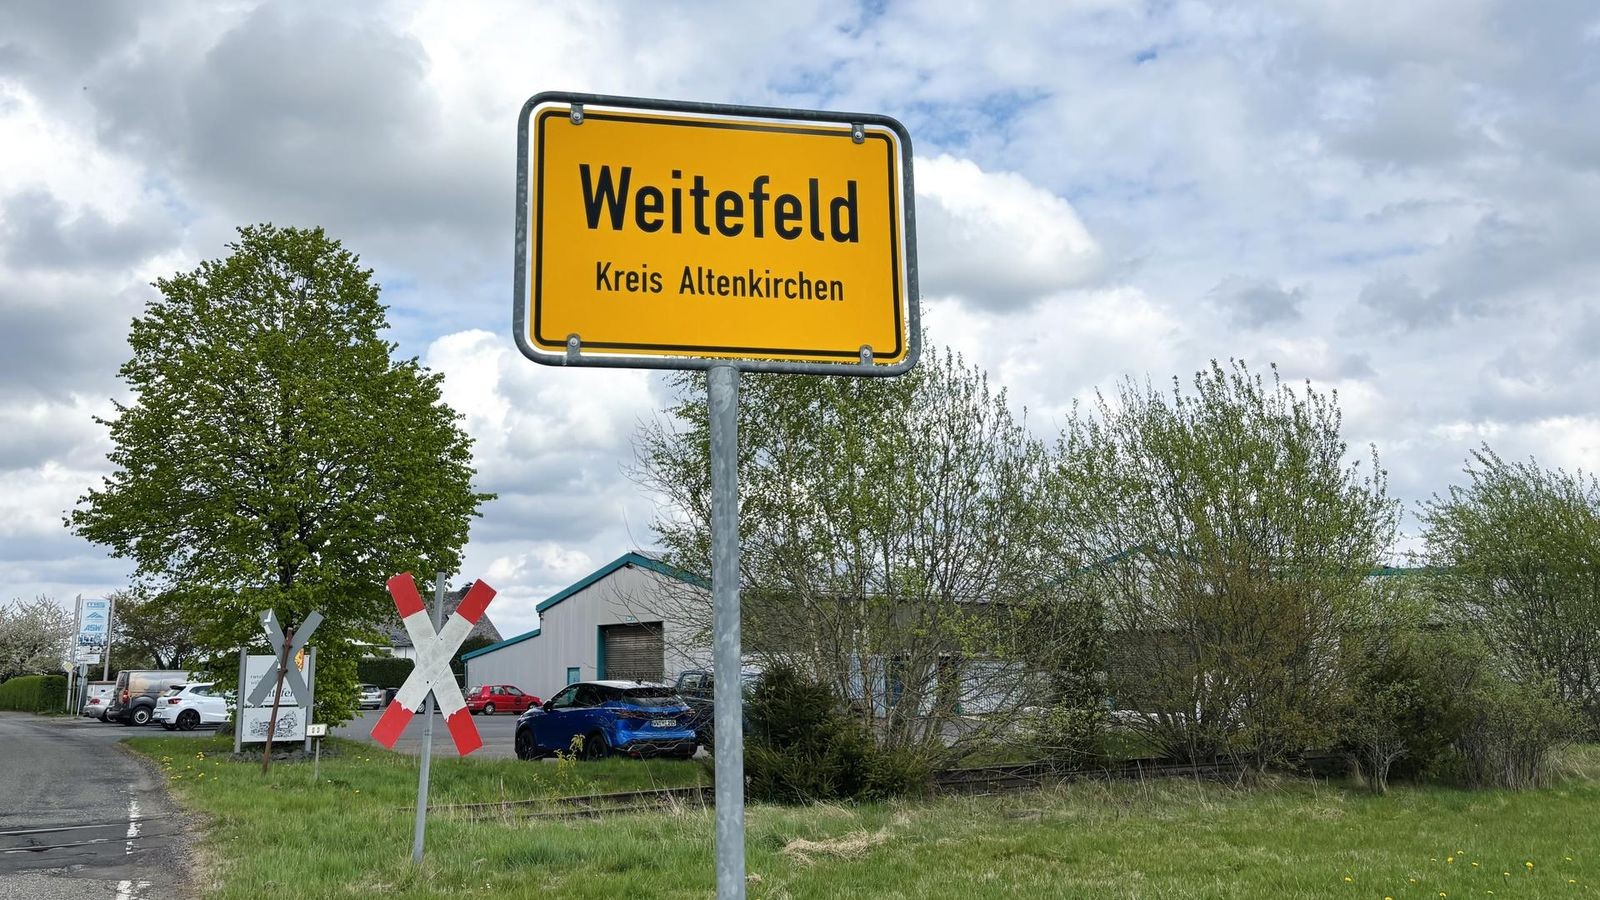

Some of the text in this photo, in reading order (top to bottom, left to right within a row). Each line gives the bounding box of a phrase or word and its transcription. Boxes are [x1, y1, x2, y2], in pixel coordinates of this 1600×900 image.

[579, 164, 858, 243] Weitefeld
[596, 262, 844, 301] Kreis Altenkirchen
